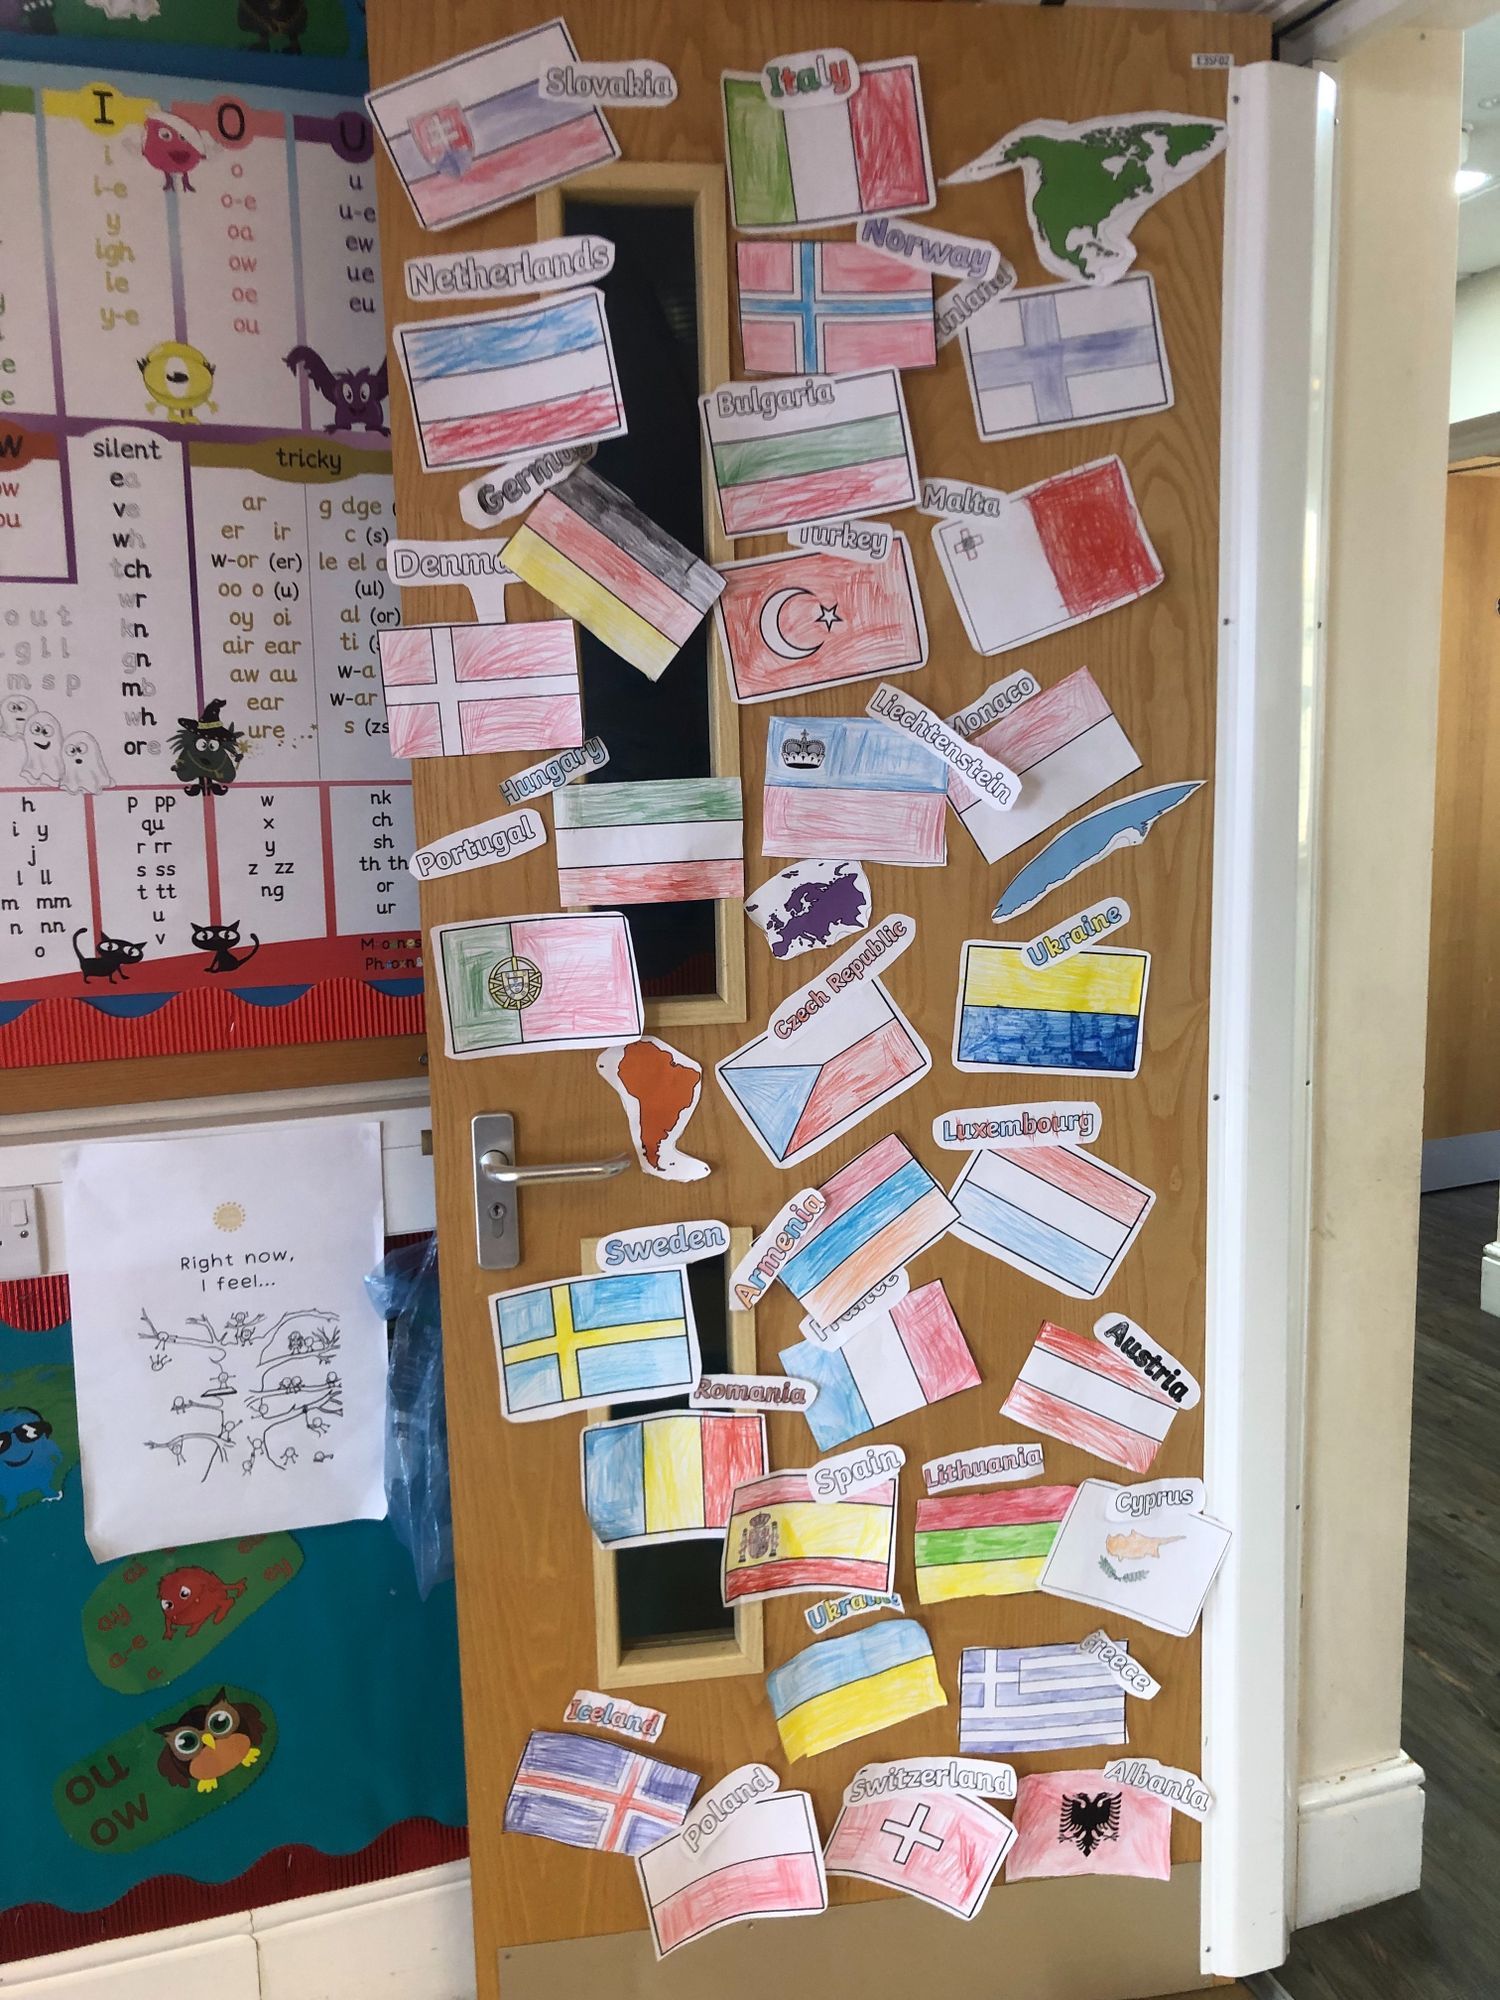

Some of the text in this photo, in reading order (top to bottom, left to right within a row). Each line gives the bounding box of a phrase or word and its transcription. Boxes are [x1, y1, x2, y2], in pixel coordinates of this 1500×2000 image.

[546, 67, 673, 98] Slovakia
[765, 54, 852, 95] Italy
[93, 91, 114, 125] I
[218, 103, 245, 140] O
[340, 120, 366, 152] U
[104, 144, 113, 166] i
[231, 164, 243, 178] o
[350, 175, 362, 190] u
[221, 194, 256, 210] o-e
[340, 205, 376, 223] u-e
[107, 214, 121, 236] y
[228, 224, 254, 241] oa
[346, 236, 373, 252] ew
[862, 217, 991, 278] Norway
[229, 256, 257, 272] ow
[410, 240, 609, 295] Netherlands
[347, 266, 374, 283] ue
[232, 288, 257, 304] oe
[938, 267, 1012, 336] inland
[350, 298, 375, 313] eu
[100, 308, 139, 330] y-e
[234, 319, 259, 334] ou
[717, 379, 835, 420] Bulgaria
[94, 438, 161, 459] silent
[276, 448, 341, 475] tricky
[243, 496, 267, 511] ar
[320, 500, 331, 519] g
[342, 496, 381, 520] dge
[922, 484, 1000, 517] Malta
[221, 522, 291, 540] er ir
[345, 527, 388, 546] c (s)
[211, 553, 302, 573] w-or (er)
[320, 552, 337, 570] le
[348, 552, 366, 571] el
[219, 582, 299, 601] oo o (u)
[355, 580, 384, 599] (ul)
[230, 608, 291, 632] oy oi
[341, 605, 400, 626] al (or)
[223, 636, 301, 654] air ear
[340, 633, 359, 650] ti
[230, 669, 297, 682] aw au
[338, 666, 374, 678] w-a
[247, 697, 284, 710] ear
[330, 693, 377, 706] w-ar
[249, 725, 285, 738] ure
[345, 721, 354, 733] s
[871, 689, 1011, 805] Liechtenstein
[499, 736, 606, 804] Hungary
[22, 797, 35, 812] h
[128, 796, 175, 813] p pp
[261, 796, 274, 806] w
[371, 790, 391, 804] nk
[142, 820, 165, 836] qu
[264, 818, 274, 829] x
[373, 812, 393, 826] ch
[13, 821, 48, 842] i y
[137, 842, 172, 853] r rr
[266, 841, 275, 857] y
[374, 834, 394, 848] sh
[416, 815, 536, 877] Portugal
[28, 846, 36, 866] j
[359, 856, 409, 871] th th
[18, 870, 52, 885] l ll
[137, 865, 175, 877] s ss
[249, 863, 294, 875] z zz
[137, 884, 176, 899] t tt
[262, 886, 283, 901] ng
[377, 882, 394, 892] or
[2, 897, 72, 910] m mm
[377, 903, 396, 914] ur
[153, 911, 165, 922] u
[10, 922, 65, 934] n nn
[1027, 906, 1122, 966] Ukraine
[156, 934, 165, 944] v
[35, 947, 45, 957] o
[773, 920, 907, 1040] Czech Republic
[942, 1111, 1094, 1142] Luxembourg
[605, 1225, 725, 1266] Sweden
[735, 1194, 826, 1311] Armenia
[181, 1251, 293, 1273] Right now,
[202, 1275, 275, 1291] I feel...
[1103, 1320, 1189, 1403] Austria
[694, 1378, 806, 1405] Romania
[814, 1448, 902, 1495] Spain
[925, 1446, 1043, 1488] Lithuania
[1115, 1487, 1194, 1517] Cyprus
[98, 1603, 131, 1631] ay
[147, 1666, 163, 1681] a
[567, 1699, 661, 1736] Iceland
[66, 1754, 130, 1805] ou
[851, 1761, 1012, 1801] Switzerland
[1104, 1761, 1210, 1811] Albania
[90, 1793, 150, 1846] ow
[682, 1768, 774, 1853] Poland
